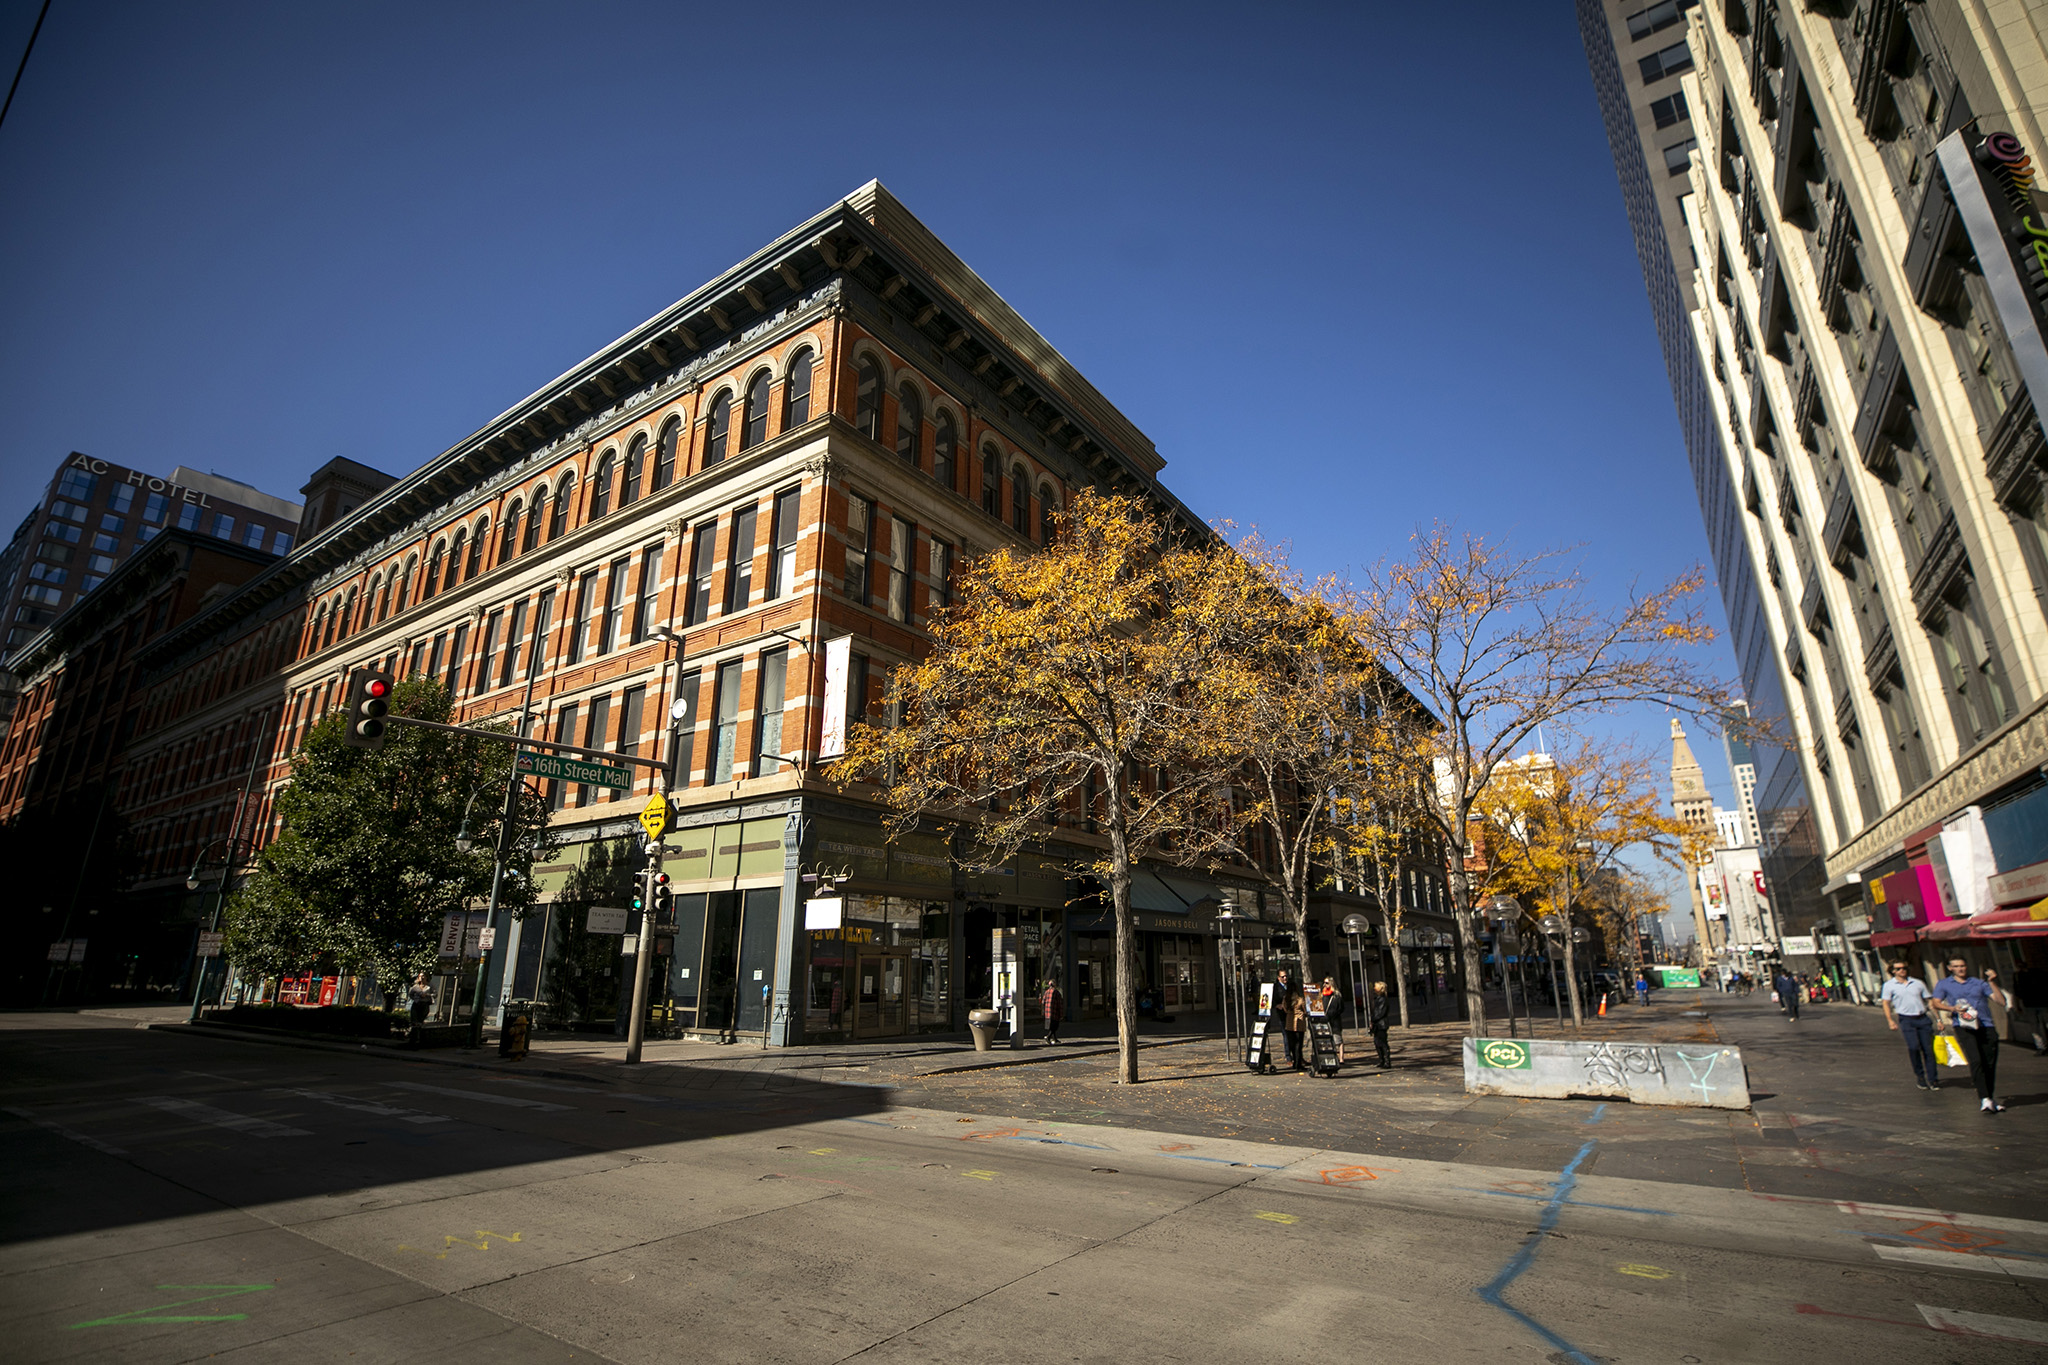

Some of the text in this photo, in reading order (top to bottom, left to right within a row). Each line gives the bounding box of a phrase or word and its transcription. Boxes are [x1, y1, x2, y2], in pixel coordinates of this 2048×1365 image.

[71, 454, 211, 508] AC HOTEL
[534, 757, 629, 787] 16th Street Mall
[828, 843, 841, 851] TEA
[843, 845, 862, 854] WITH
[1154, 918, 1198, 929] JASON'S DELI
[446, 914, 461, 951] DENVER
[1024, 933, 1039, 942] PACE
[1490, 1048, 1519, 1060] PCL
